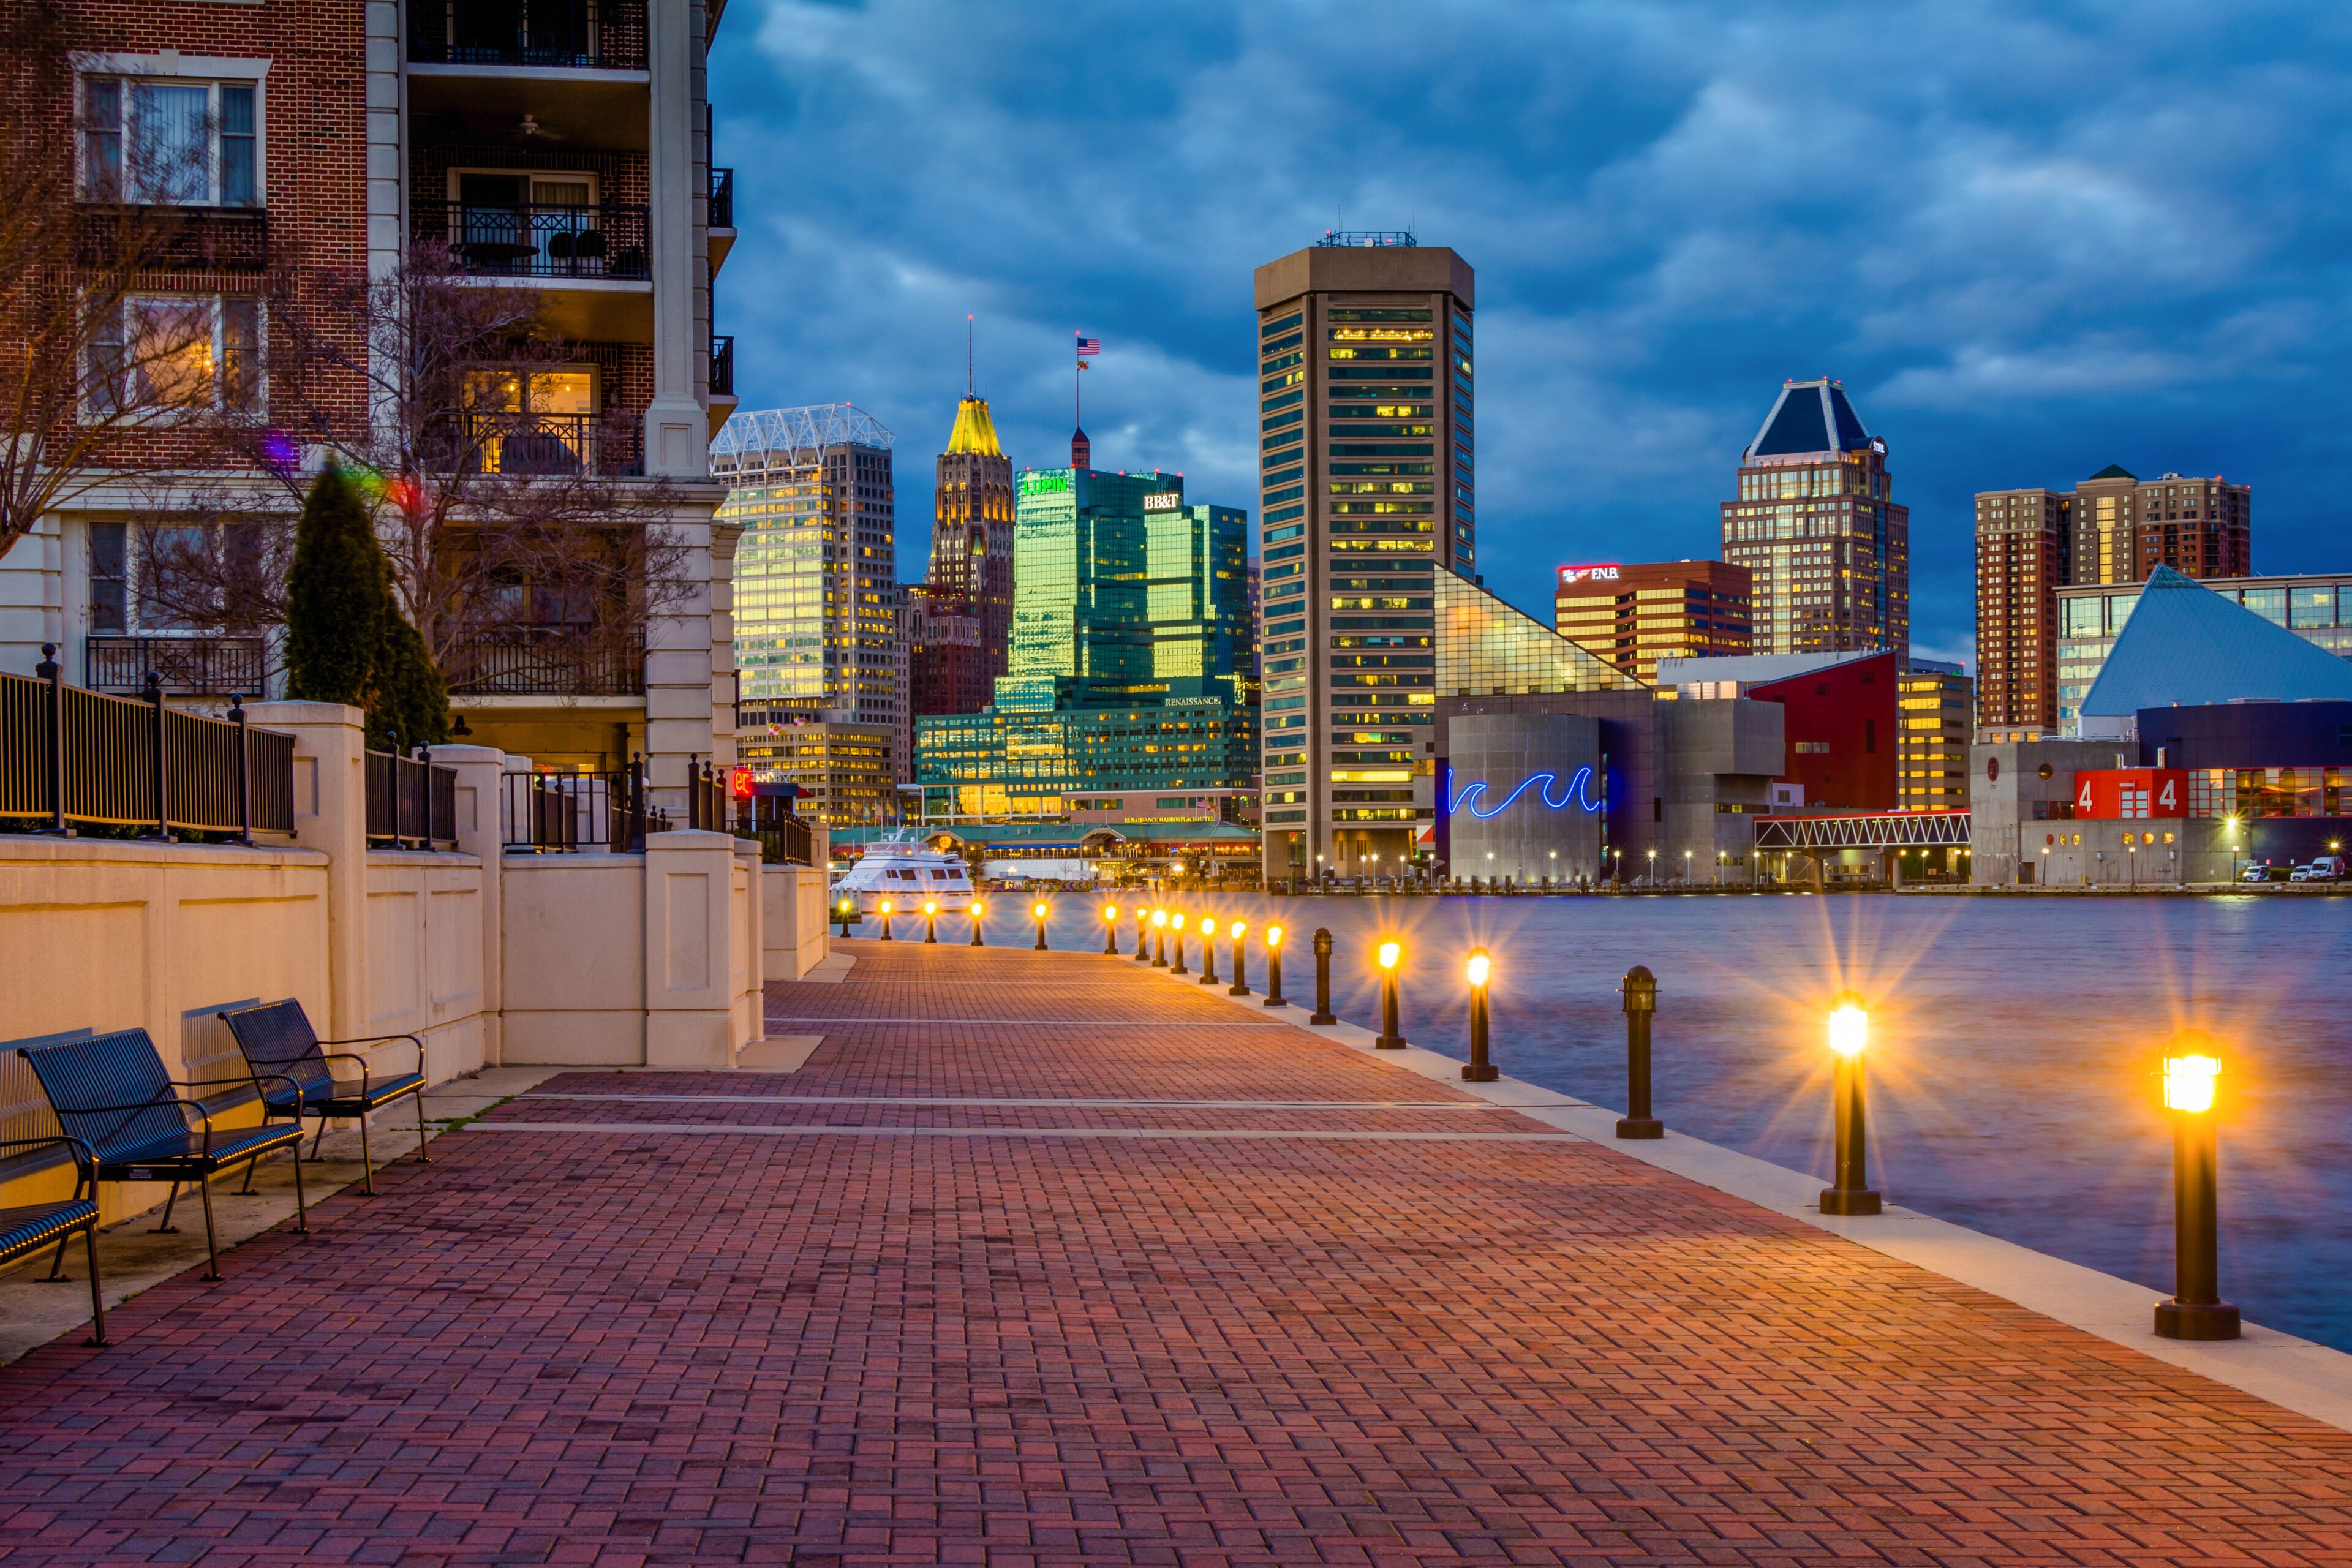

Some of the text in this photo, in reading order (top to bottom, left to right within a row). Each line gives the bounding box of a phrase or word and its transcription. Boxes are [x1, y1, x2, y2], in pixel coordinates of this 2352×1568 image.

[1023, 478, 1067, 494] LUPIN
[1144, 494, 1178, 510] BB&T
[1592, 567, 1619, 579] F.N.B.
[2079, 780, 2092, 812] 4
[2159, 779, 2176, 810] 4
